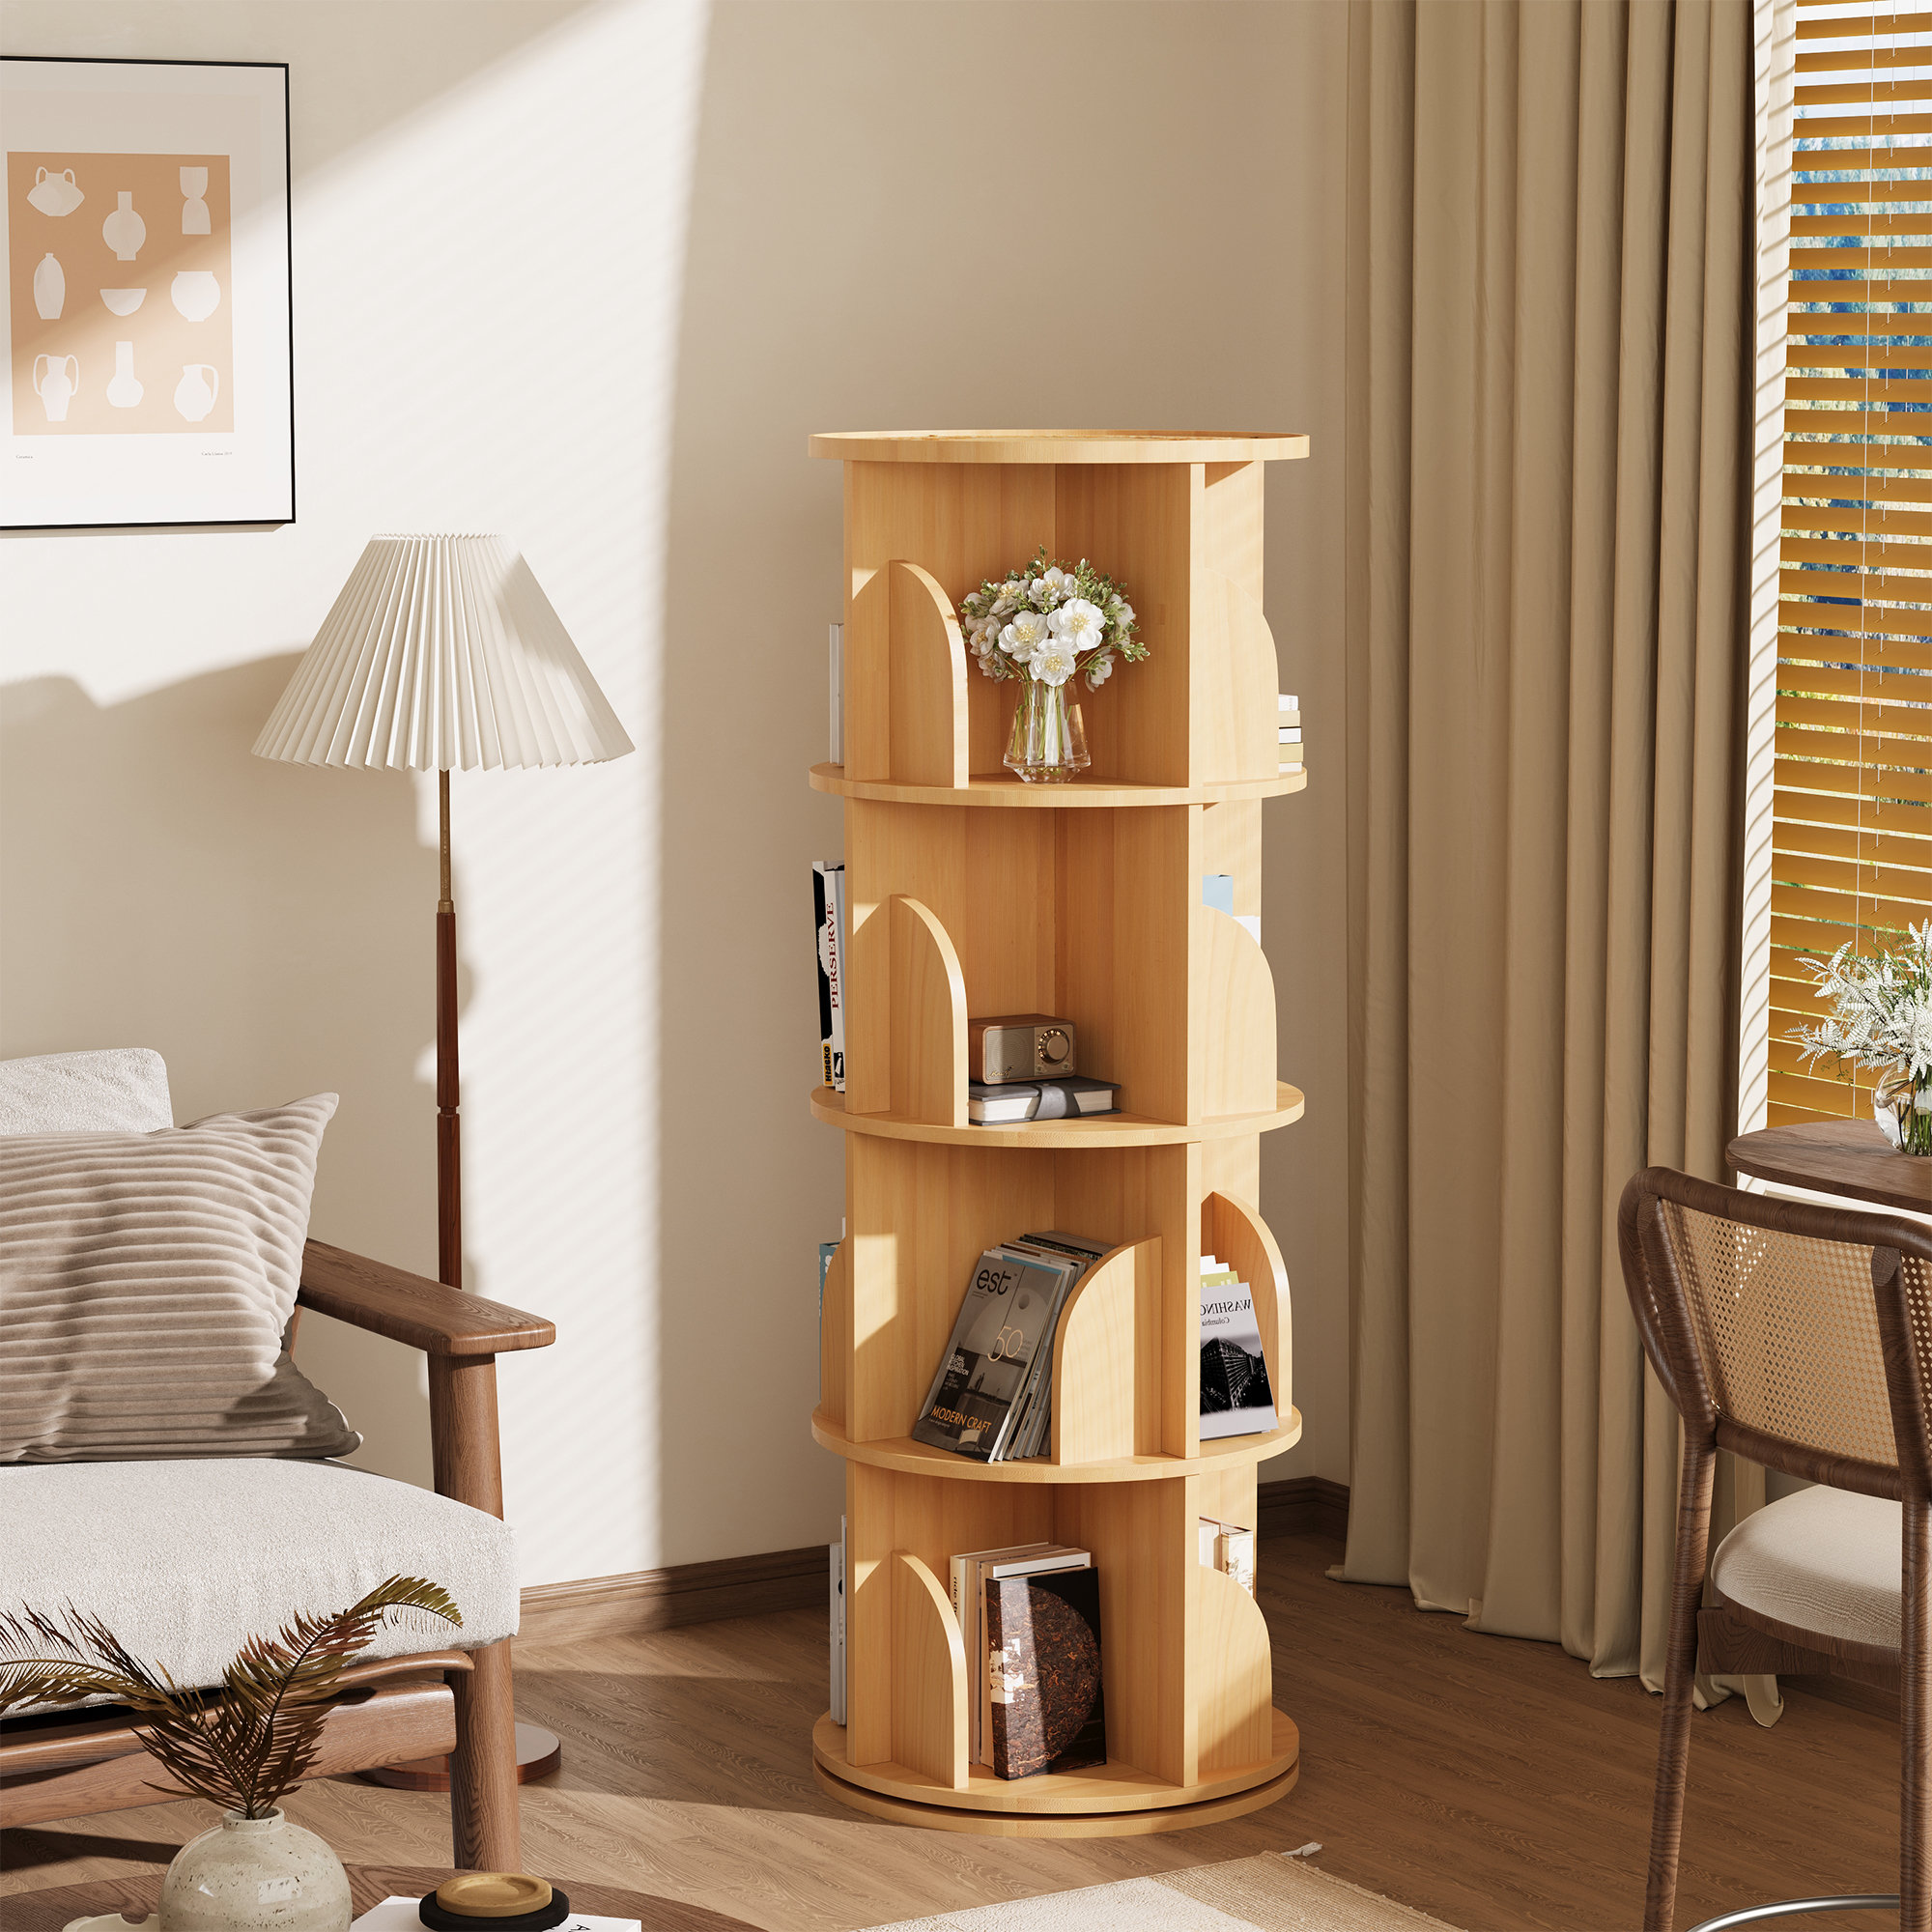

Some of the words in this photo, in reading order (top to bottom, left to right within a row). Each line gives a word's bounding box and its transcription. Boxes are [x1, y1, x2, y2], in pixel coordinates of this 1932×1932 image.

[826, 902, 839, 1009] PERSERVE
[976, 1268, 1012, 1295] est
[987, 1325, 1023, 1362] 50
[930, 1406, 967, 1428] MODERN
[966, 1416, 993, 1434] CRAFT
